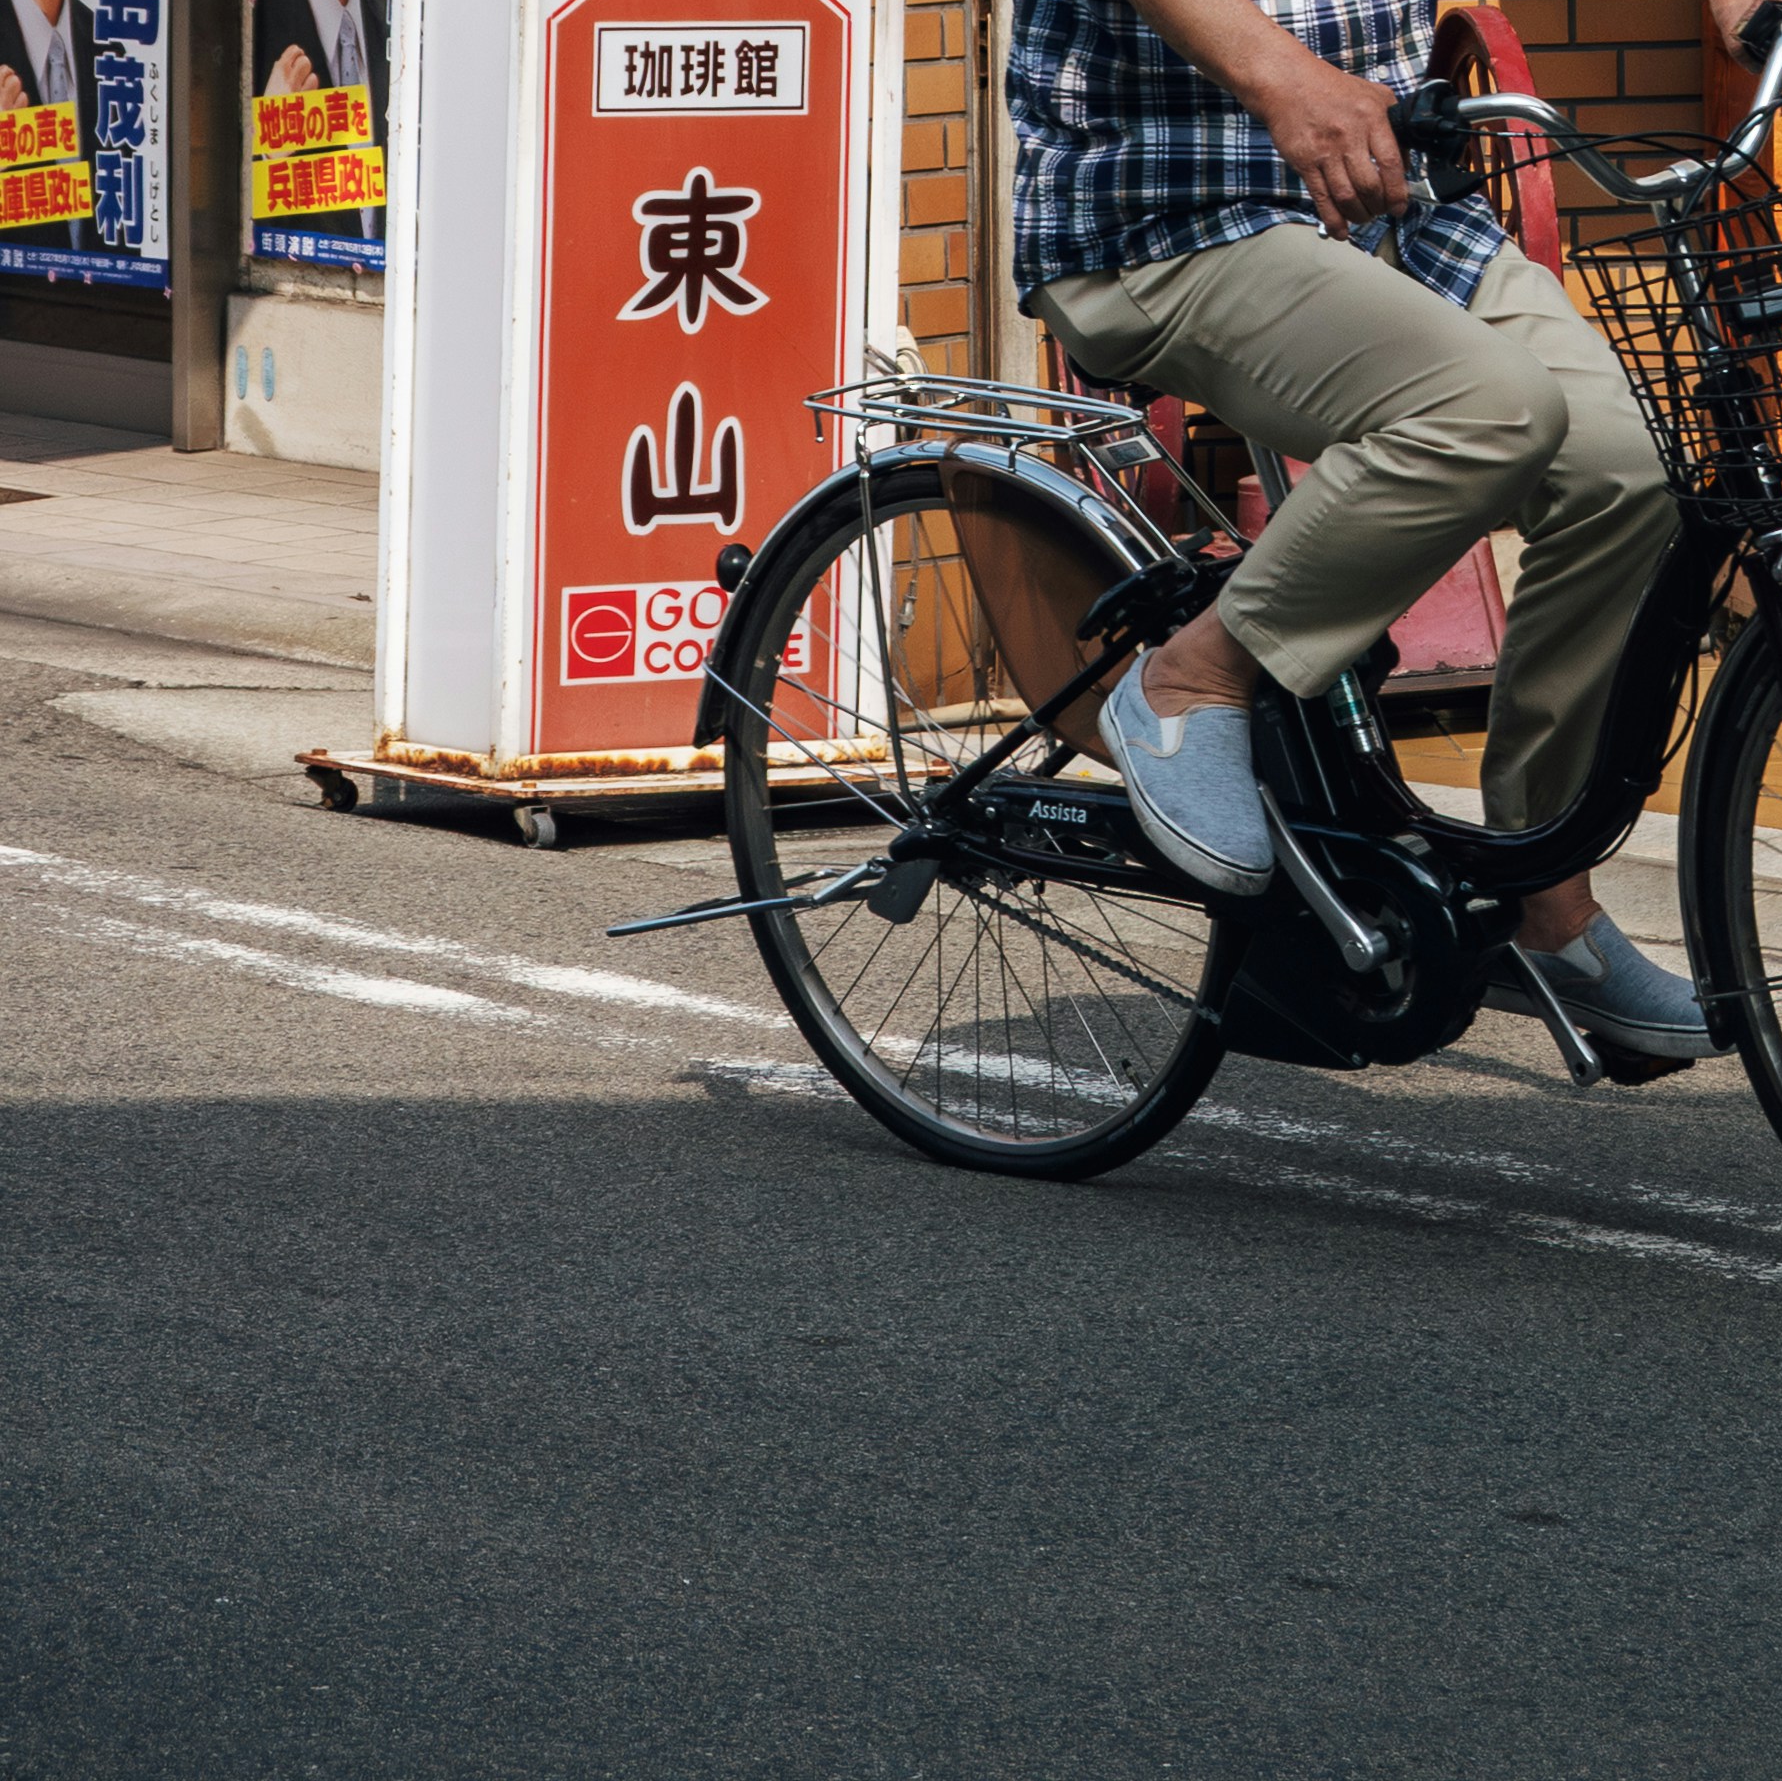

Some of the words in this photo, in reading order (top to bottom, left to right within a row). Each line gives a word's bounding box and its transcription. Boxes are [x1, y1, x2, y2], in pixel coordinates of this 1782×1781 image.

[623, 39, 780, 99] 珈琲館
[149, 62, 161, 146] ふくしま
[258, 90, 368, 150] 地域の声を
[0, 167, 90, 223] 庫県政に
[267, 153, 384, 213] 兵庫県政に
[617, 167, 770, 535] 東山
[1028, 799, 1088, 824] Assista
